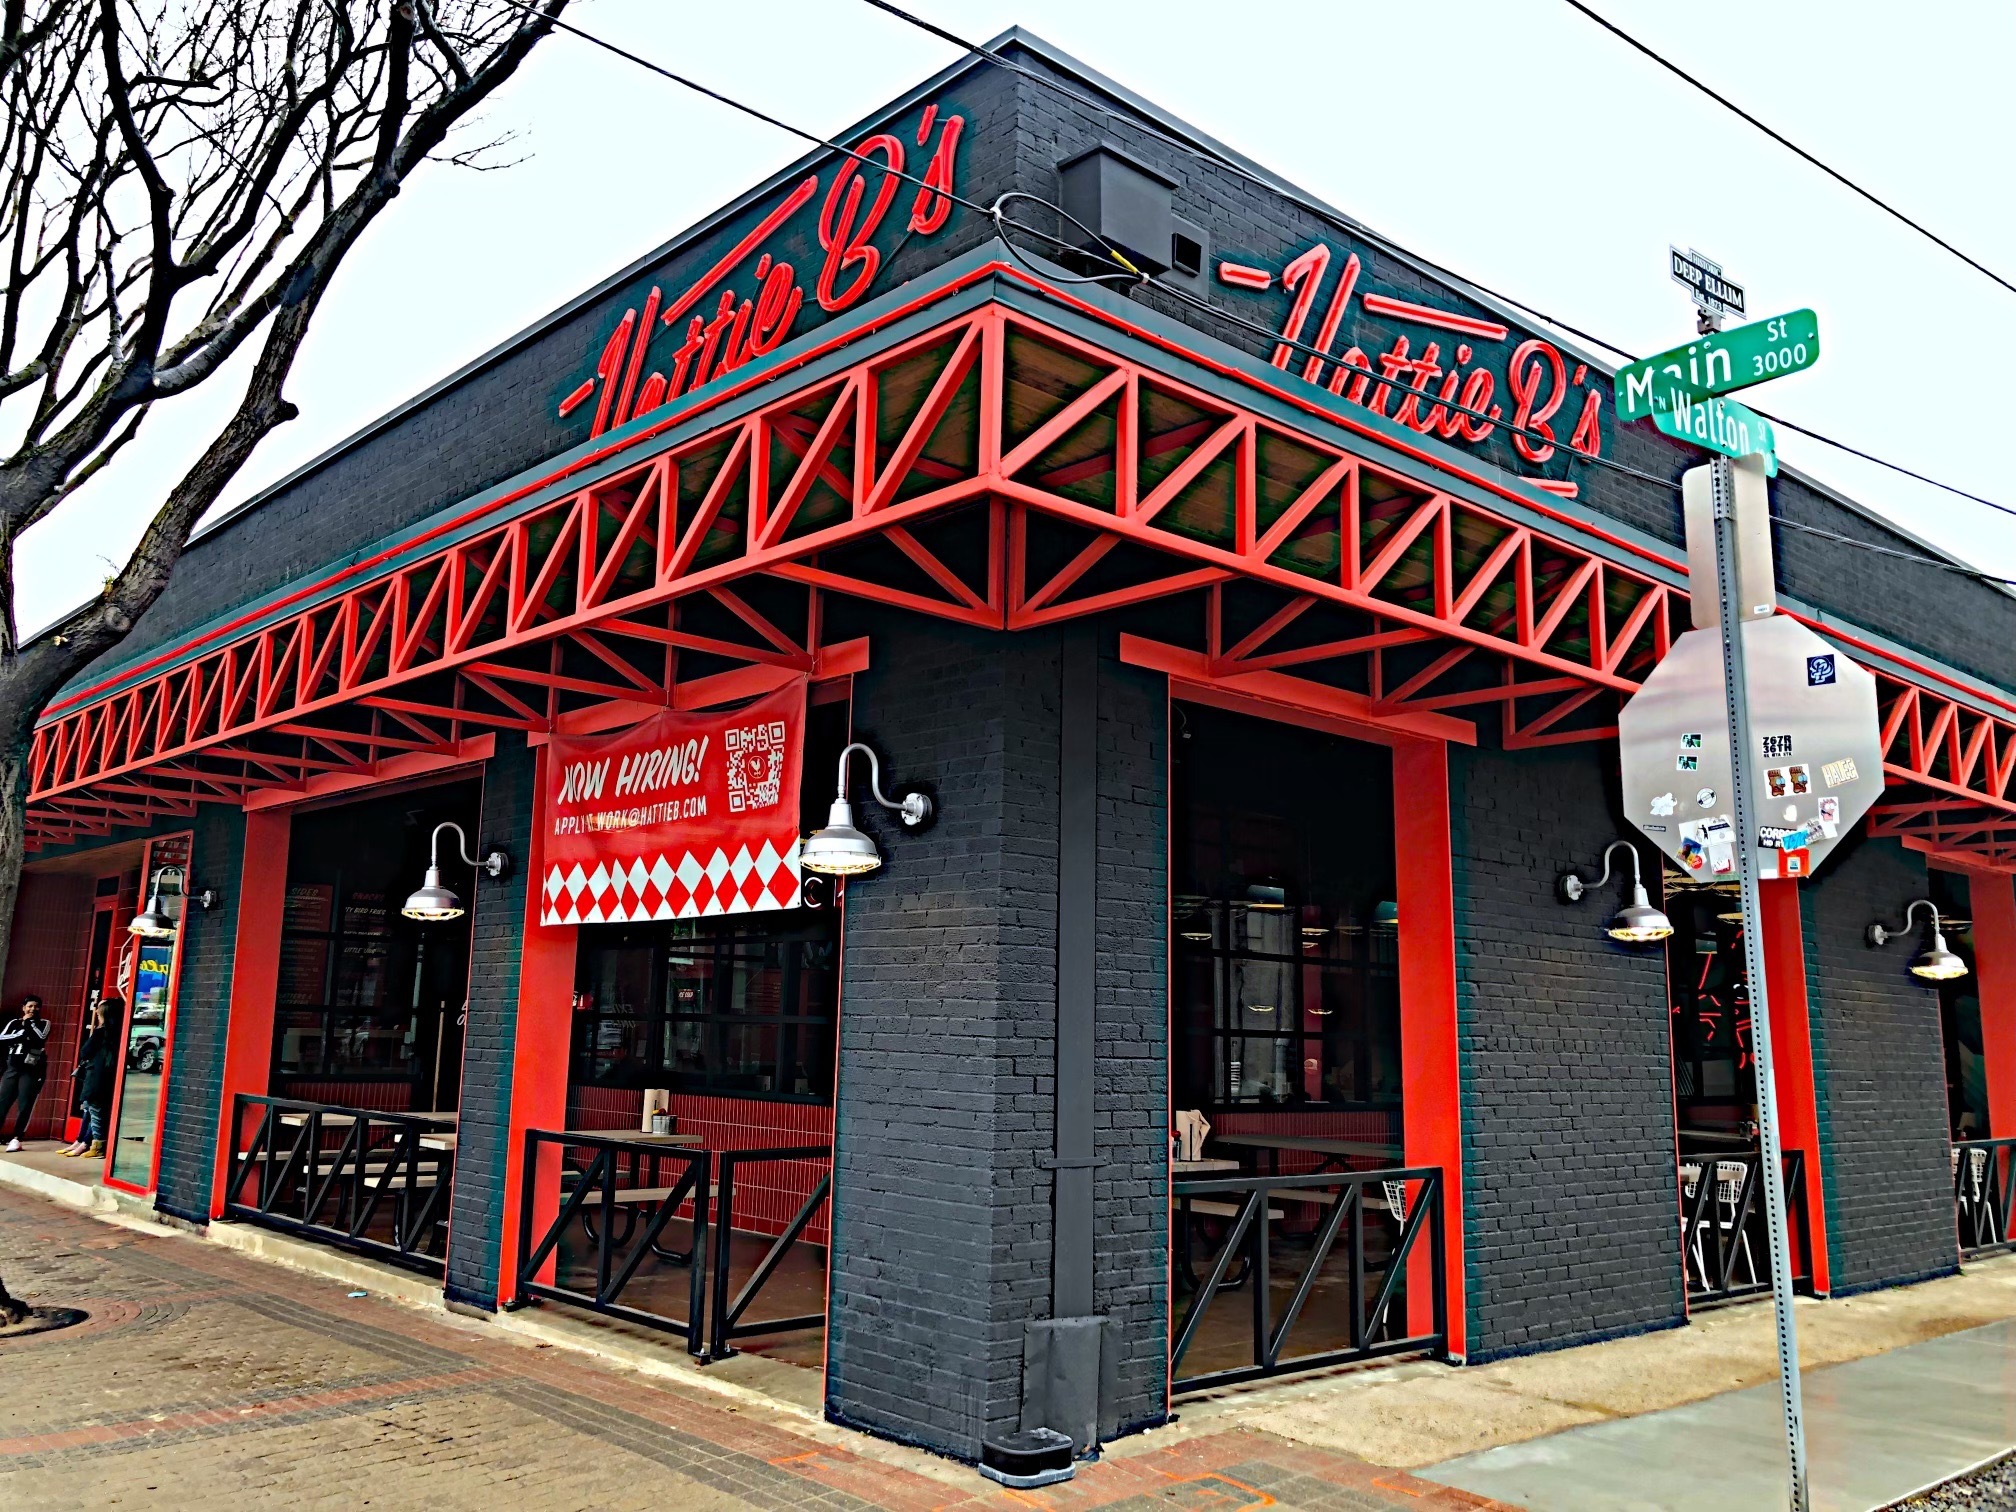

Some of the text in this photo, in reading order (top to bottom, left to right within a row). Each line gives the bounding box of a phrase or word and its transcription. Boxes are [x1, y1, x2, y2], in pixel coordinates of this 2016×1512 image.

[558, 104, 965, 440] Hattie B's
[1673, 254, 1743, 309] DEEP ELLUM
[1692, 253, 1722, 278] HISTORIC
[1219, 243, 1602, 464] Hattie B's
[1766, 317, 1788, 343] St
[1752, 343, 1807, 377] 3000
[1670, 387, 1750, 455] Walton
[557, 734, 710, 806] NOW HIRING!
[554, 815, 586, 836] APPLY
[596, 795, 707, 832] WORK@HATTIEB.COM
